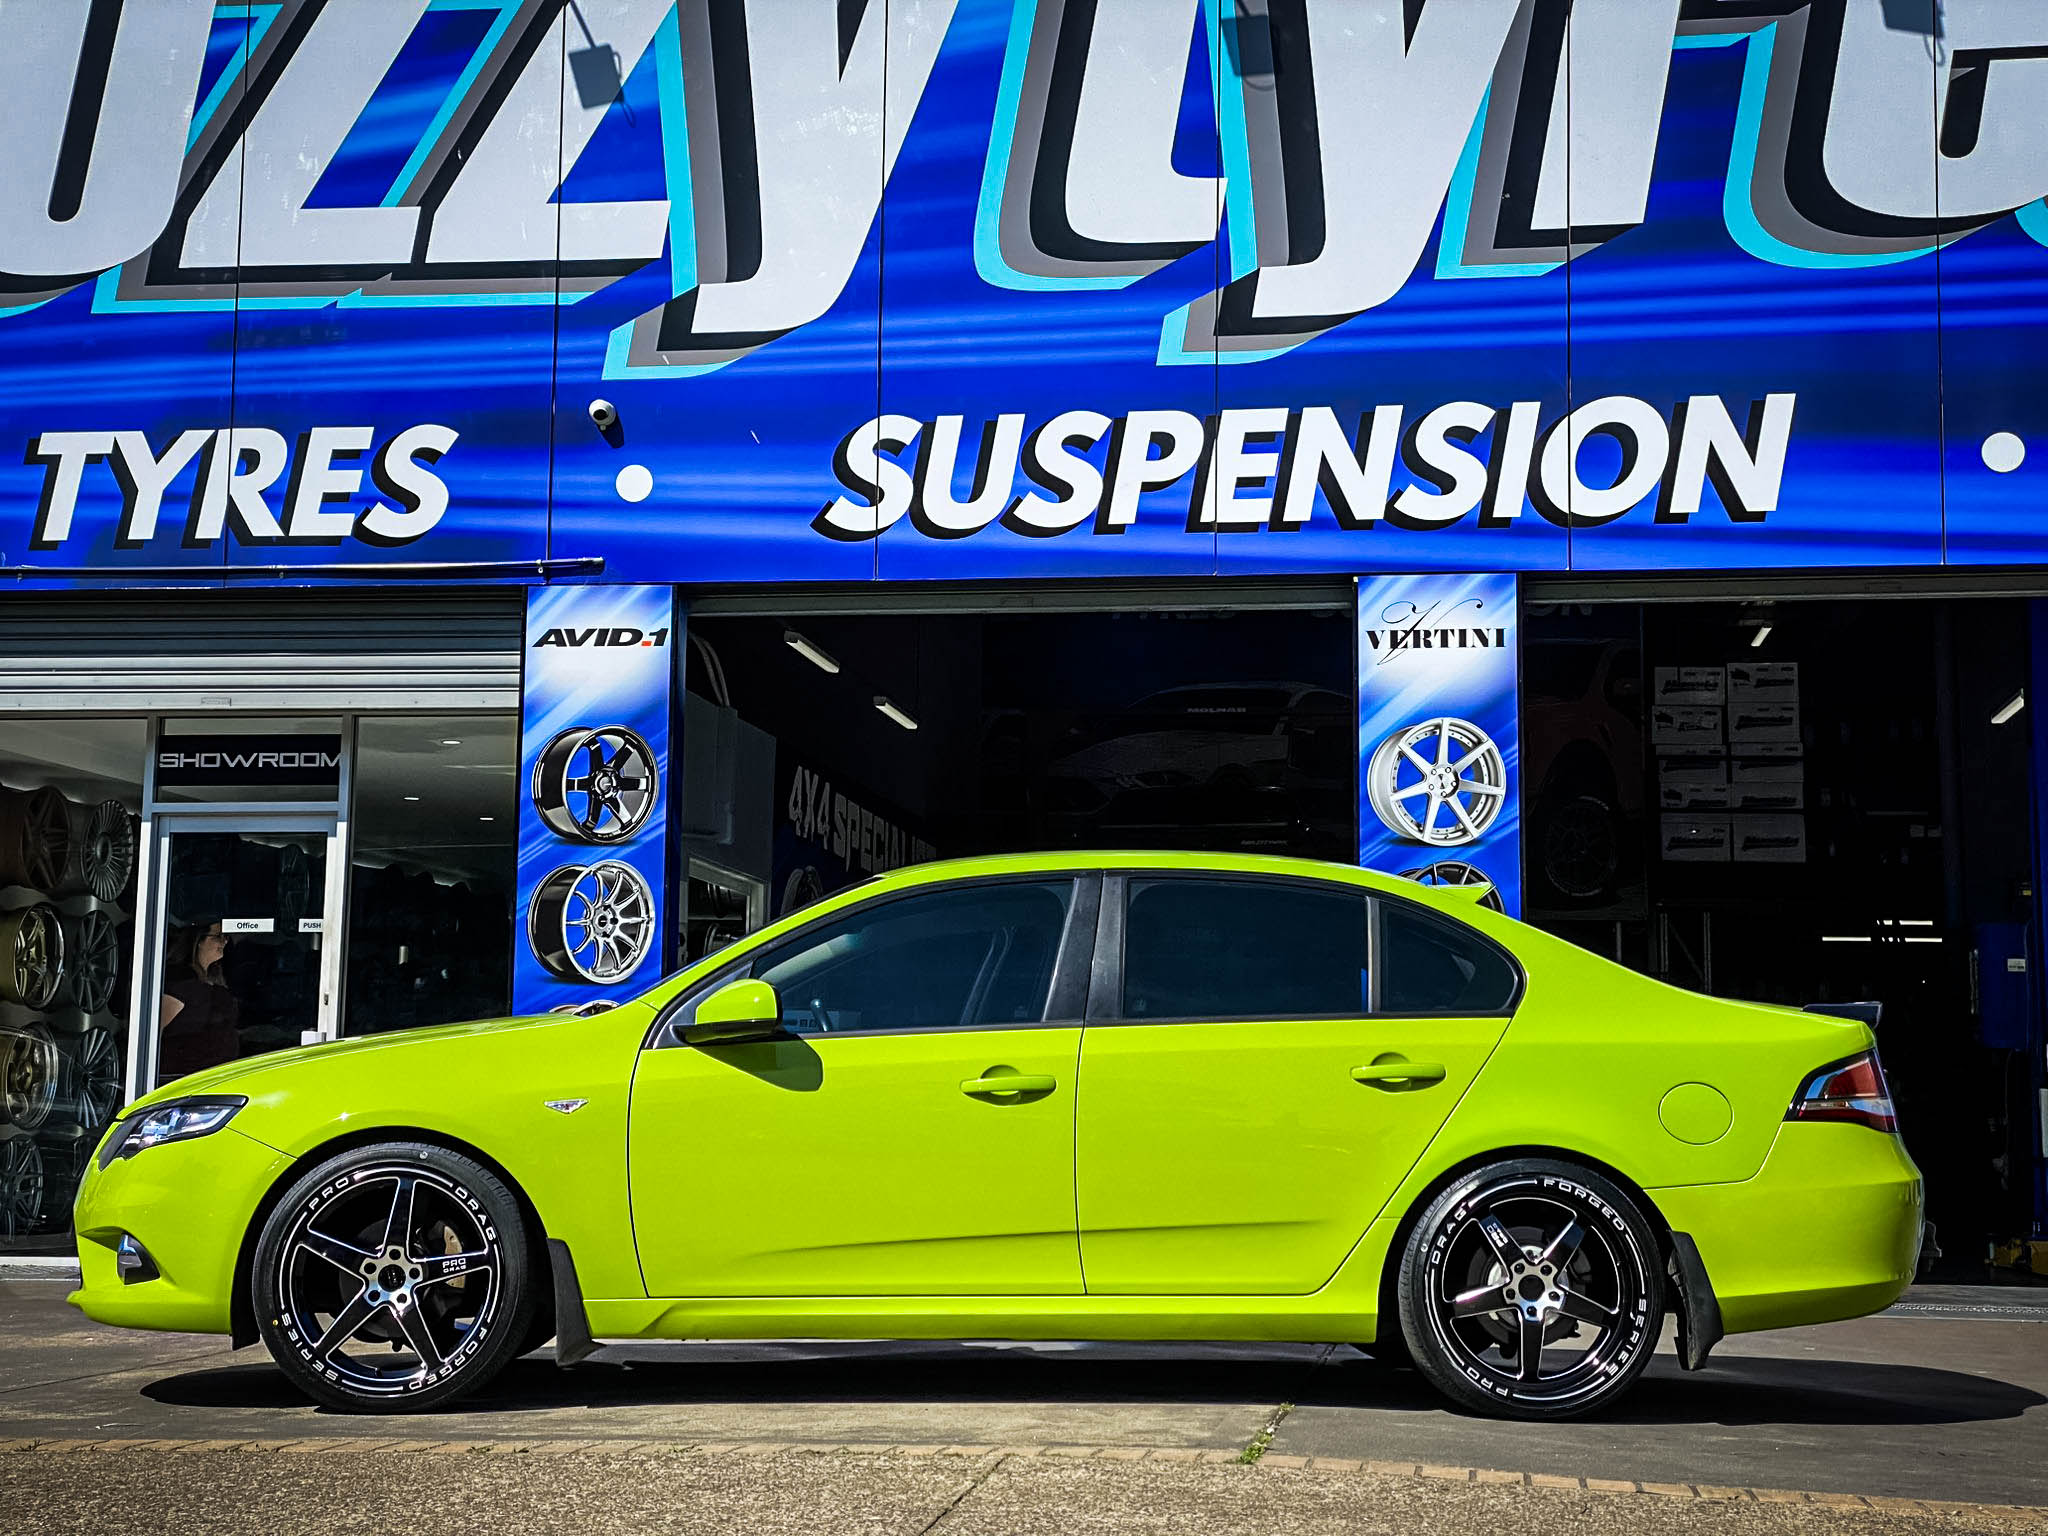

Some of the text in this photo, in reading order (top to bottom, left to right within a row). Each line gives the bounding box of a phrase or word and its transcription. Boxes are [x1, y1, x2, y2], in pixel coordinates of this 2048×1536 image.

[816, 393, 1796, 538] SUSPENSION
[32, 424, 459, 547] TYRES
[532, 627, 669, 648] AVID.1
[1366, 628, 1507, 650] VERTINI
[159, 752, 342, 768] SHOWROOM
[236, 921, 259, 930] Office
[303, 922, 322, 930] PUSH
[442, 1257, 467, 1269] PRO
[281, 1176, 498, 1391] PRO DRAG FORGED SERIES
[1430, 1178, 1649, 1398] DRAG FORGED SERIES PRO
